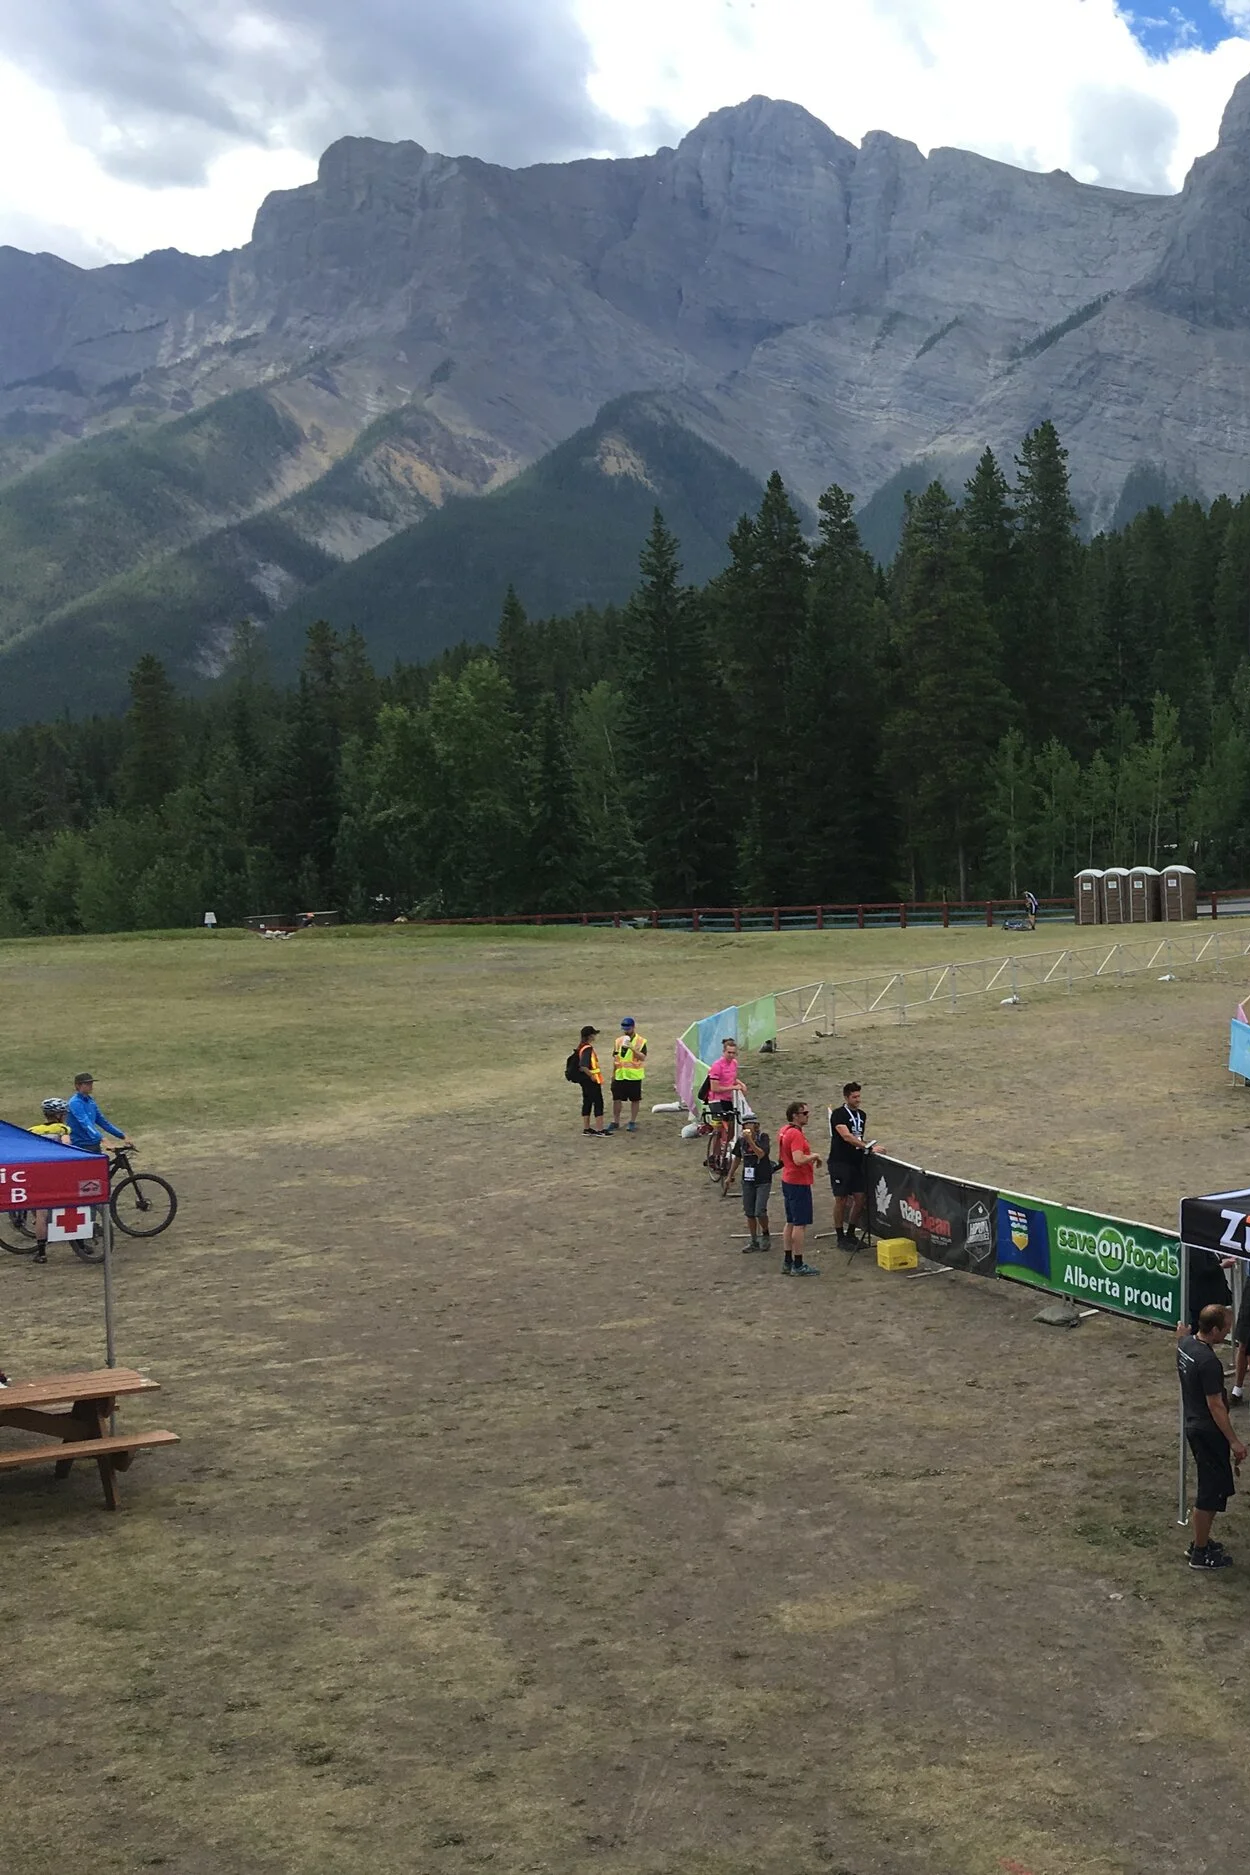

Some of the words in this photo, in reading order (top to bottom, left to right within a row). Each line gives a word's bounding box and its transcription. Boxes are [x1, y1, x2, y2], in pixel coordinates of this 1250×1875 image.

[11, 1187, 28, 1204] B
[1058, 1228, 1097, 1256] save
[1099, 1239, 1122, 1260] on
[1125, 1237, 1179, 1278] foods
[1063, 1264, 1120, 1298] Alberta
[1124, 1285, 1173, 1313] proud
